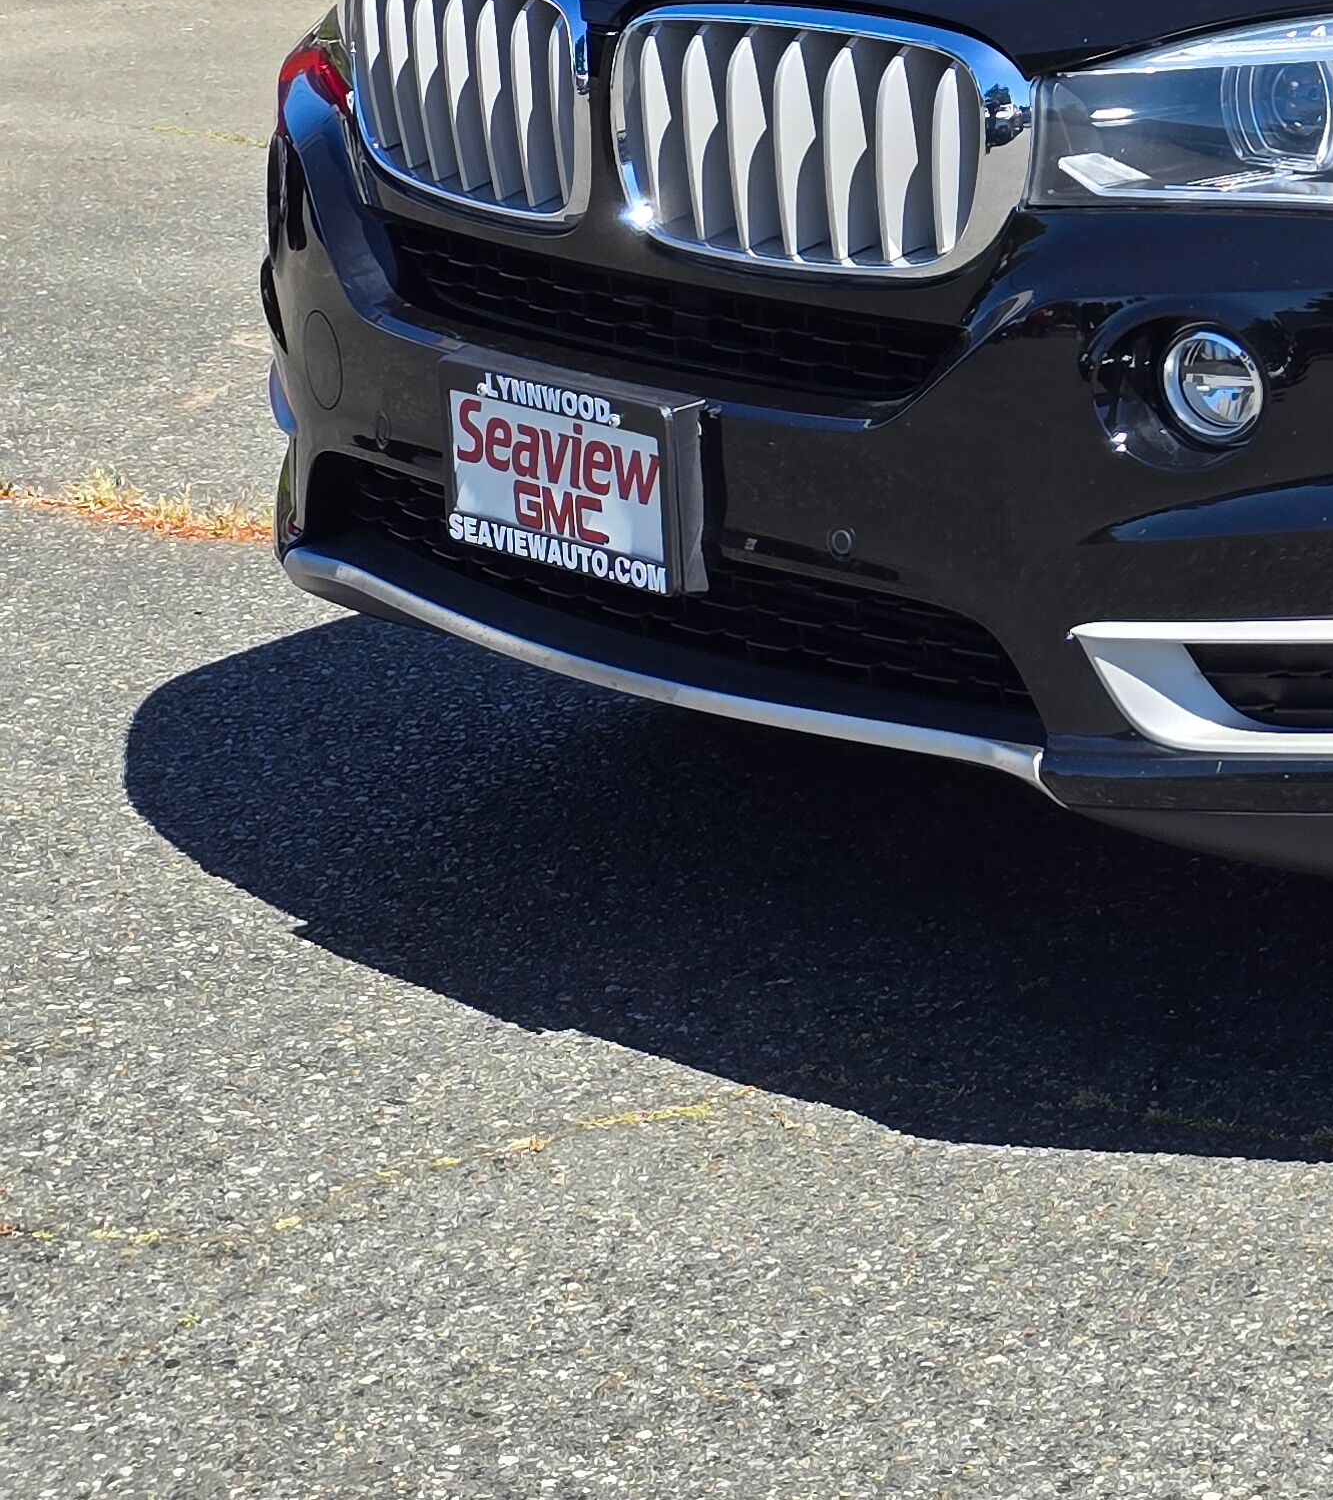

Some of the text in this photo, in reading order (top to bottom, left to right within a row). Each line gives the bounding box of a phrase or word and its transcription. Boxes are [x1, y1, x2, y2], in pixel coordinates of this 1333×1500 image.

[484, 372, 611, 424] LYNNWOOD
[456, 398, 661, 505] Seaview
[512, 479, 610, 545] GMC
[448, 513, 667, 595] SEAVIEWAUTO.COM
